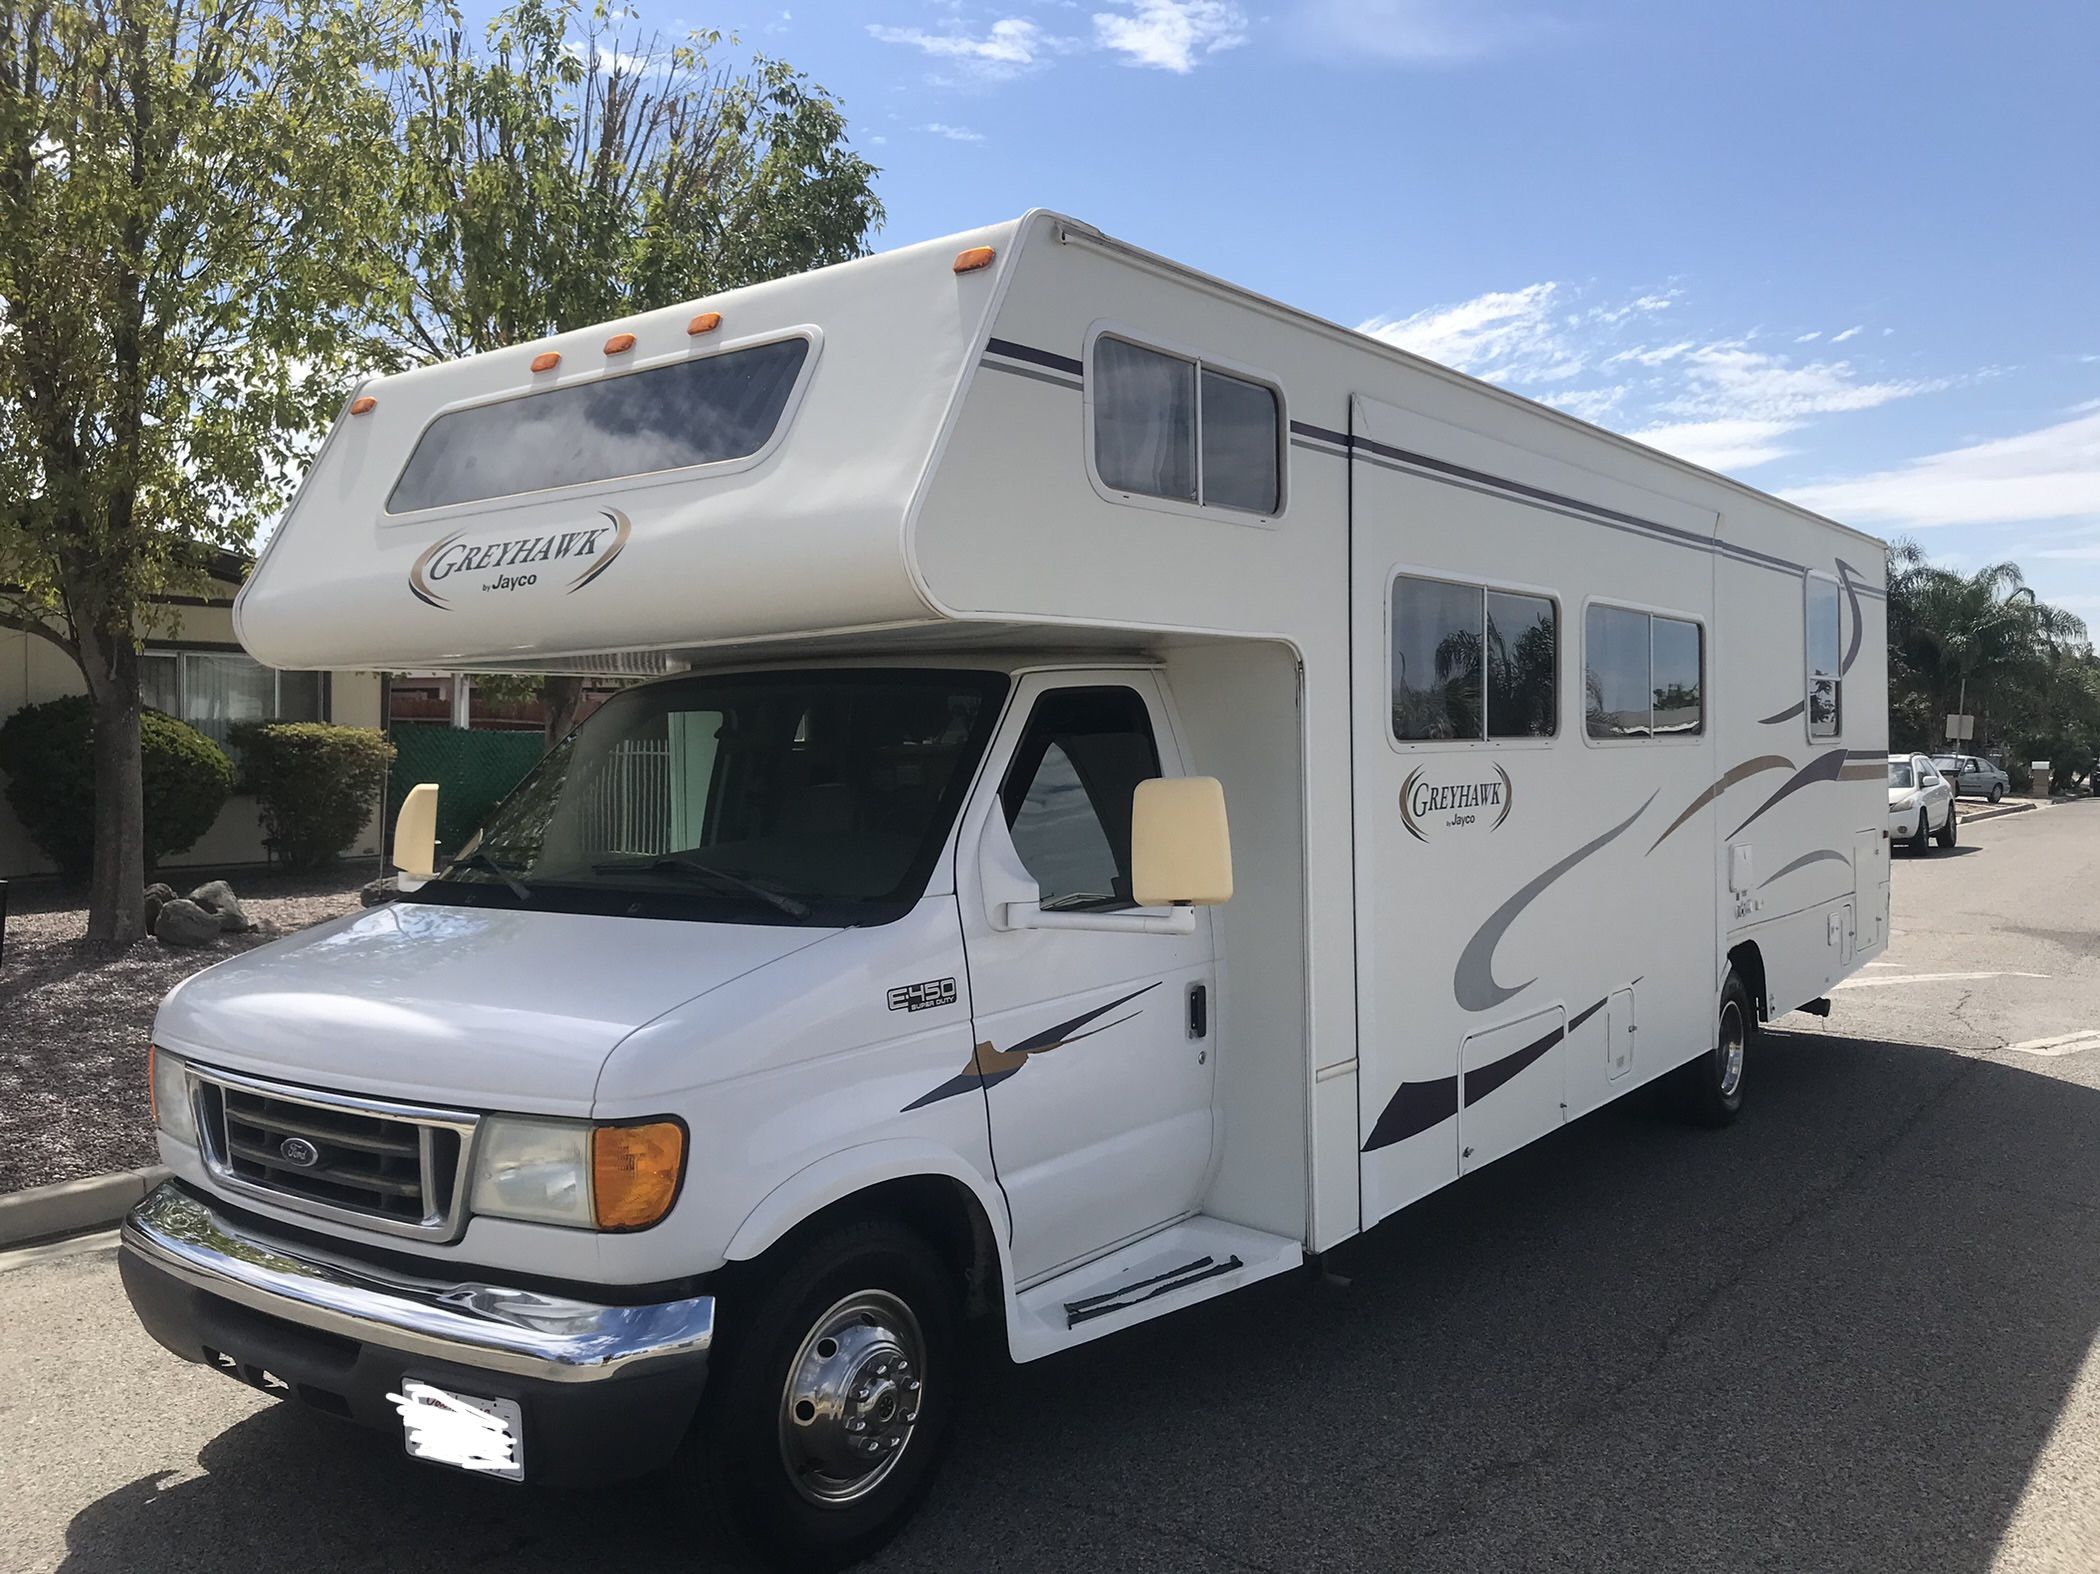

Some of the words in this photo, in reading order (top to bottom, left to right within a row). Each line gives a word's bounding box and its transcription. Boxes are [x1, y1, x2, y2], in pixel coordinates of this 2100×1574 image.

[429, 527, 610, 581] GREYHAWK
[482, 583, 491, 592] by
[492, 574, 537, 592] Jayco
[1412, 782, 1502, 818] GREYHAWK
[1451, 813, 1476, 827] Jayco
[888, 979, 956, 1010] E-450
[911, 1000, 935, 1011] SUPER
[935, 996, 955, 1006] DUTY
